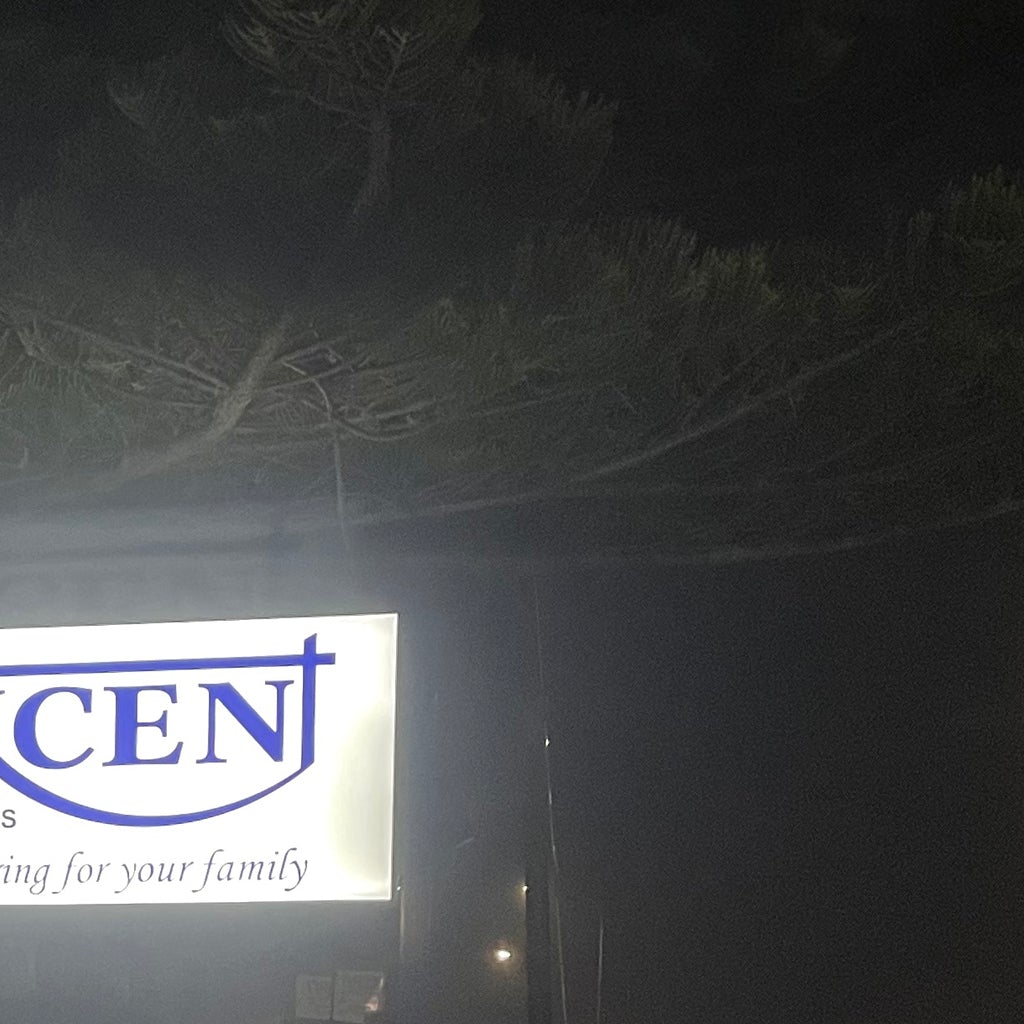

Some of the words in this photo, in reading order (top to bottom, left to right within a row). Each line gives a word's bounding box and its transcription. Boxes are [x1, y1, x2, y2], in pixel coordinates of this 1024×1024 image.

[51, 851, 111, 895] for
[113, 862, 192, 894] your
[191, 848, 309, 894] family
